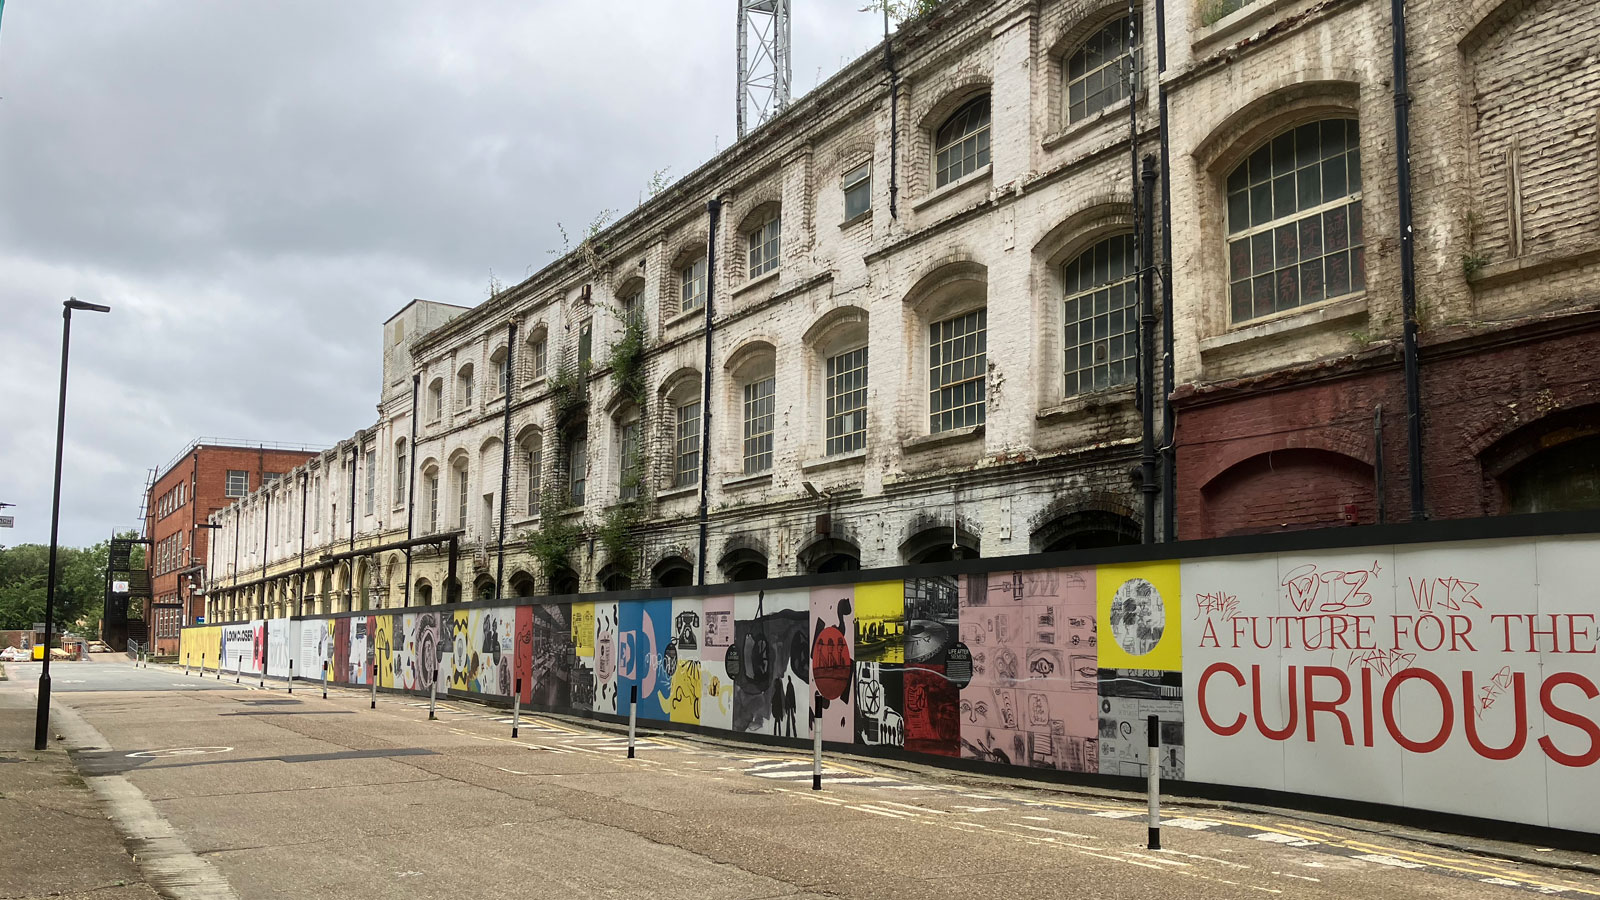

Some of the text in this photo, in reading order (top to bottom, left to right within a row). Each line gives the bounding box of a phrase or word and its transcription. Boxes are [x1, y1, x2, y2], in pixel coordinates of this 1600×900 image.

[1198, 612, 1597, 653] A FUTURE FOR THE
[1197, 661, 1600, 768] CURIOUS
